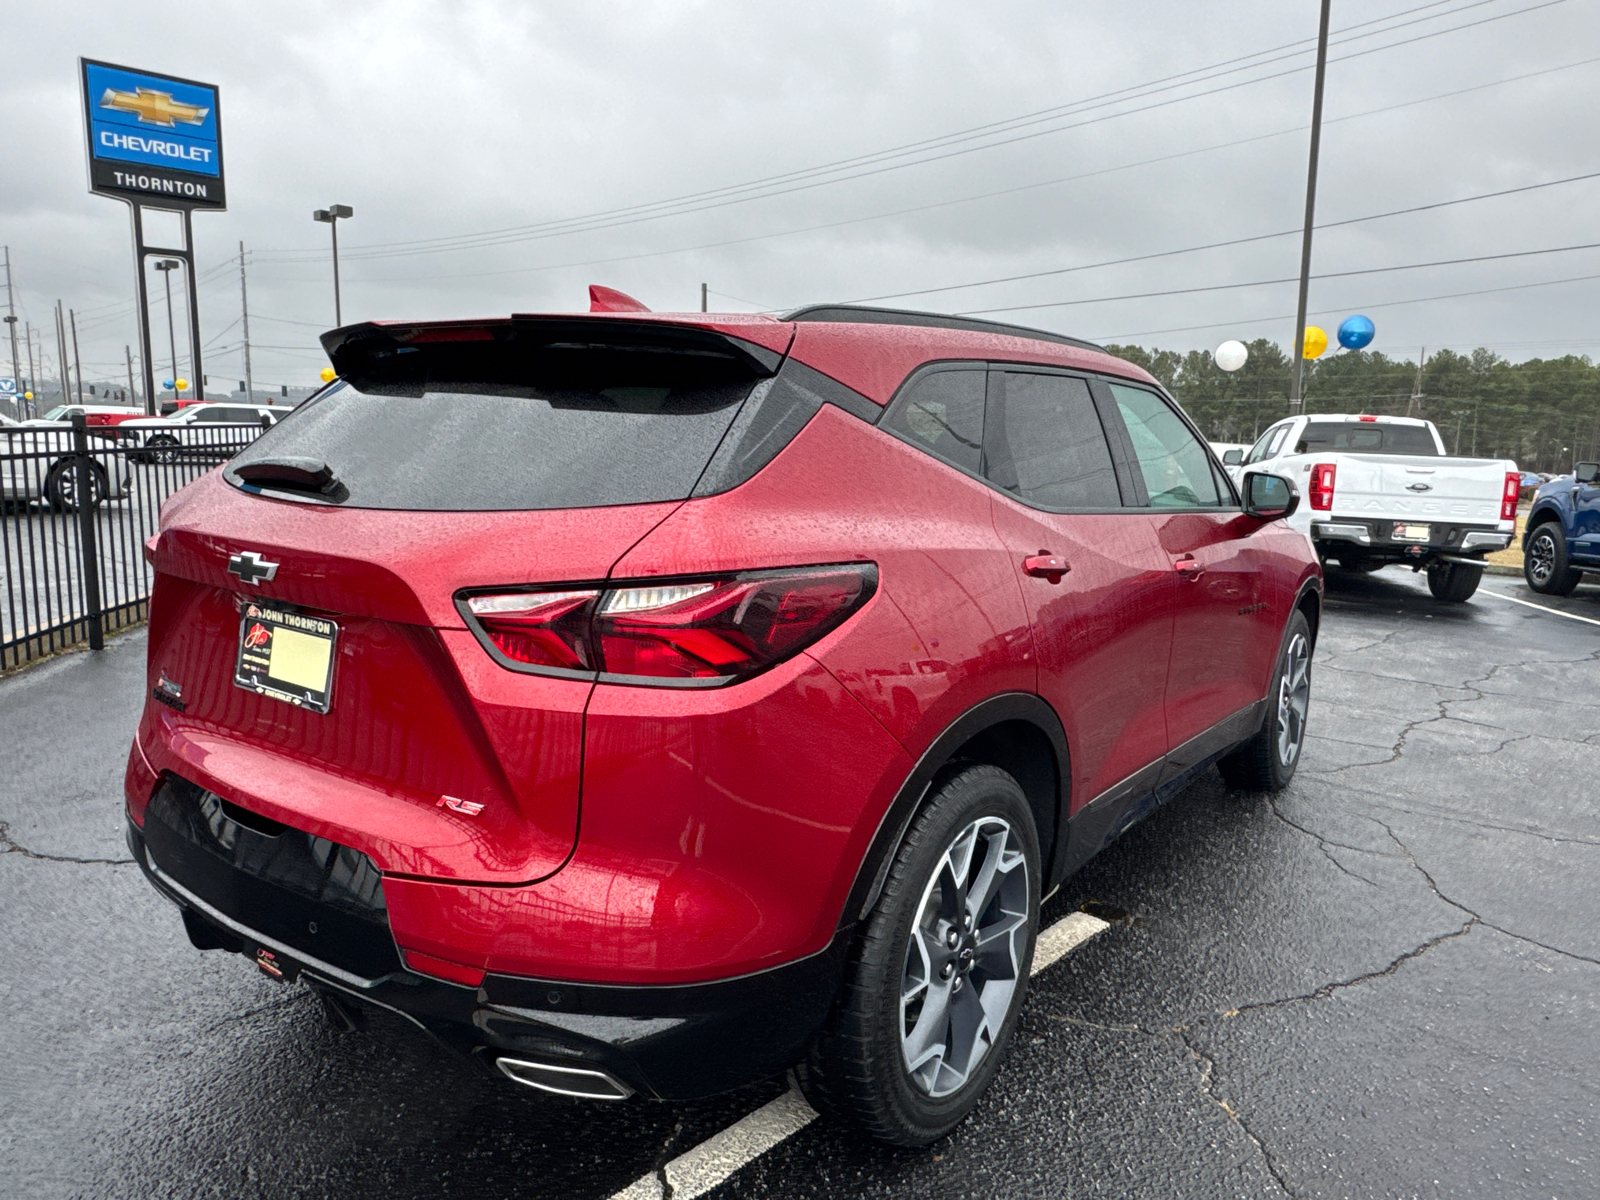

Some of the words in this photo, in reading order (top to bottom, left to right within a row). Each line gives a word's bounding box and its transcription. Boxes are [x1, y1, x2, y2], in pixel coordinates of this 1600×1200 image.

[101, 131, 212, 163] CHEVROLET
[113, 171, 207, 198] THORNTON
[1336, 498, 1497, 516] RANGER
[262, 608, 283, 624] JOHN
[436, 794, 485, 816] RS
